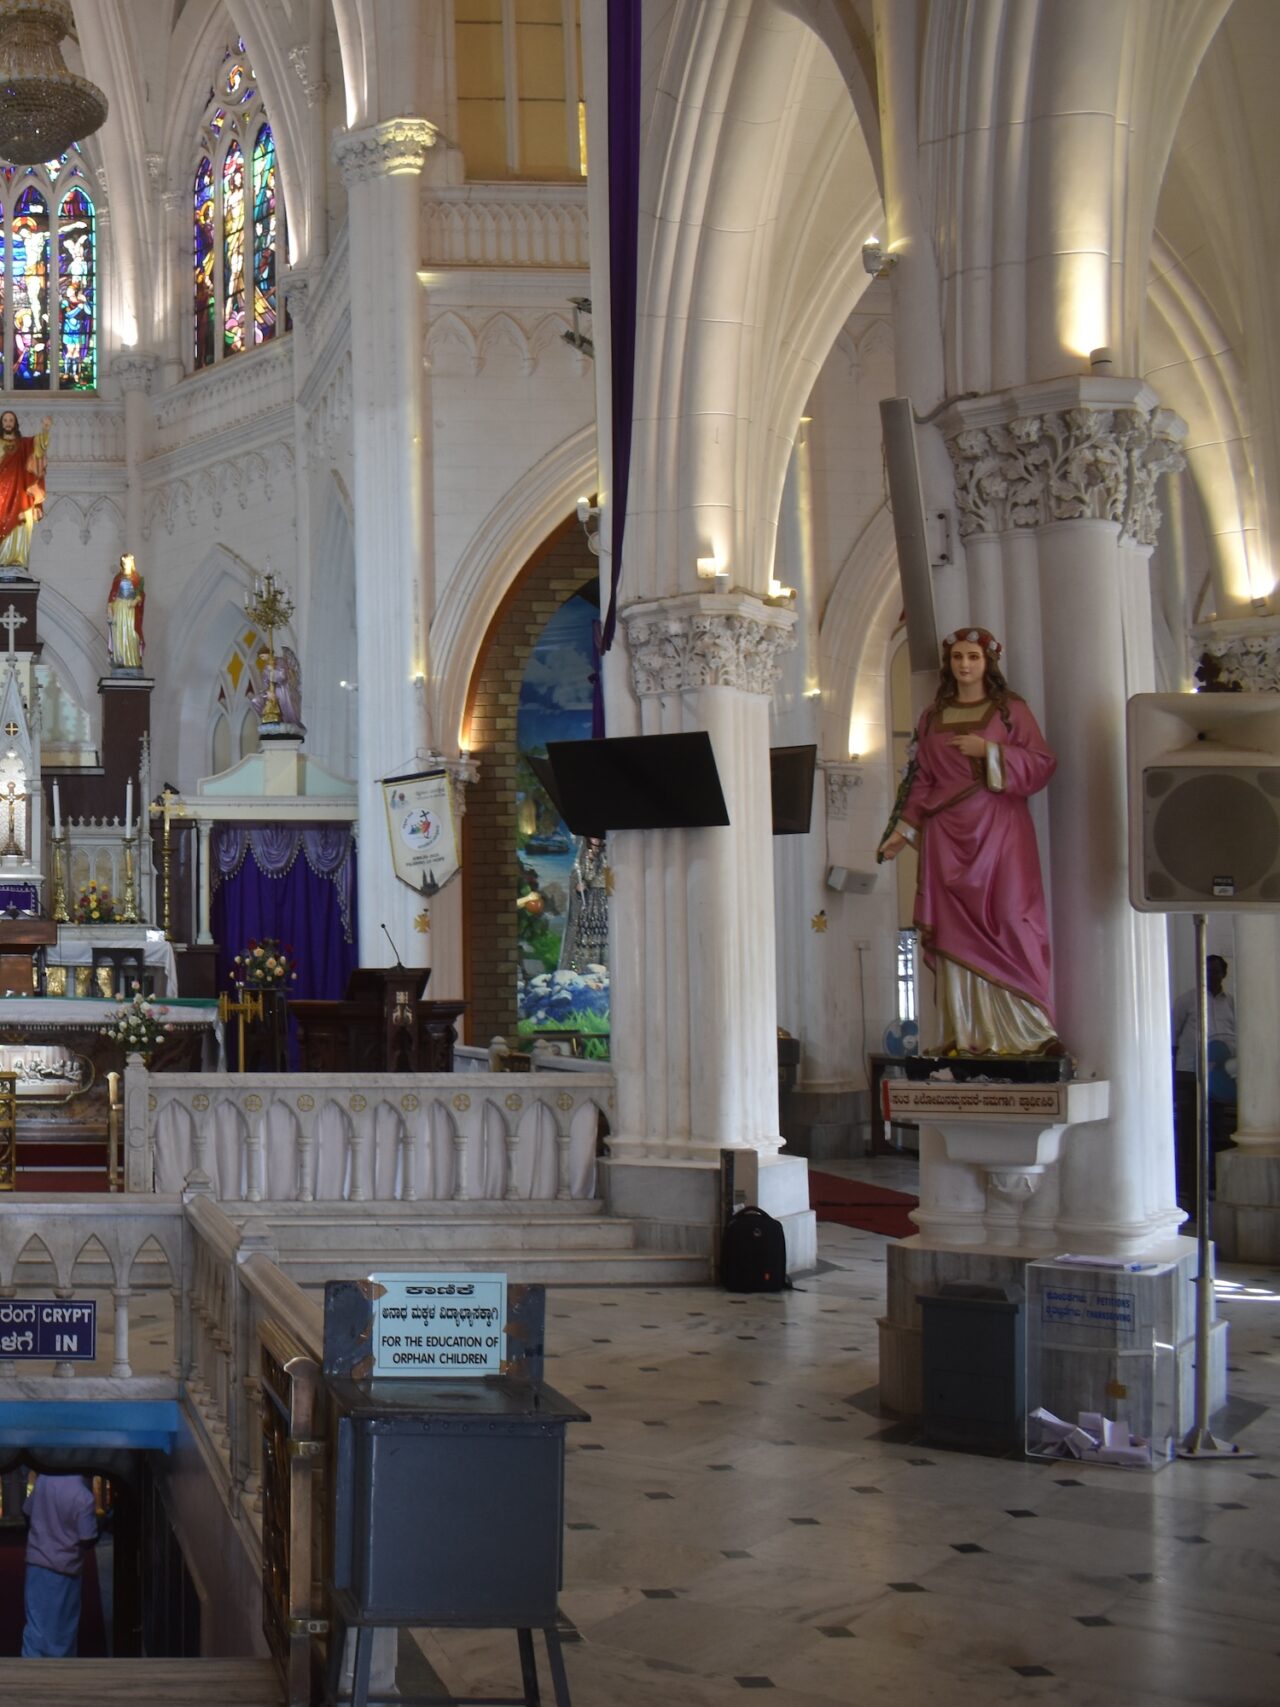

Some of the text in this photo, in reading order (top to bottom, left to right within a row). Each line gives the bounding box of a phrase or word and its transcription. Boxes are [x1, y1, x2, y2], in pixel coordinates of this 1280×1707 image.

[405, 1283, 475, 1296] ಕಾಣಿಕೆ
[42, 1308, 92, 1323] CRYPT
[382, 1306, 408, 1321] ಅನಾಥ
[411, 1305, 436, 1327] ಮಕ್ಕಳ
[55, 1334, 78, 1352] IN
[382, 1336, 499, 1347] FOR THE EDUCATION OF
[392, 1353, 487, 1364] ORPHAN CHILDREN
